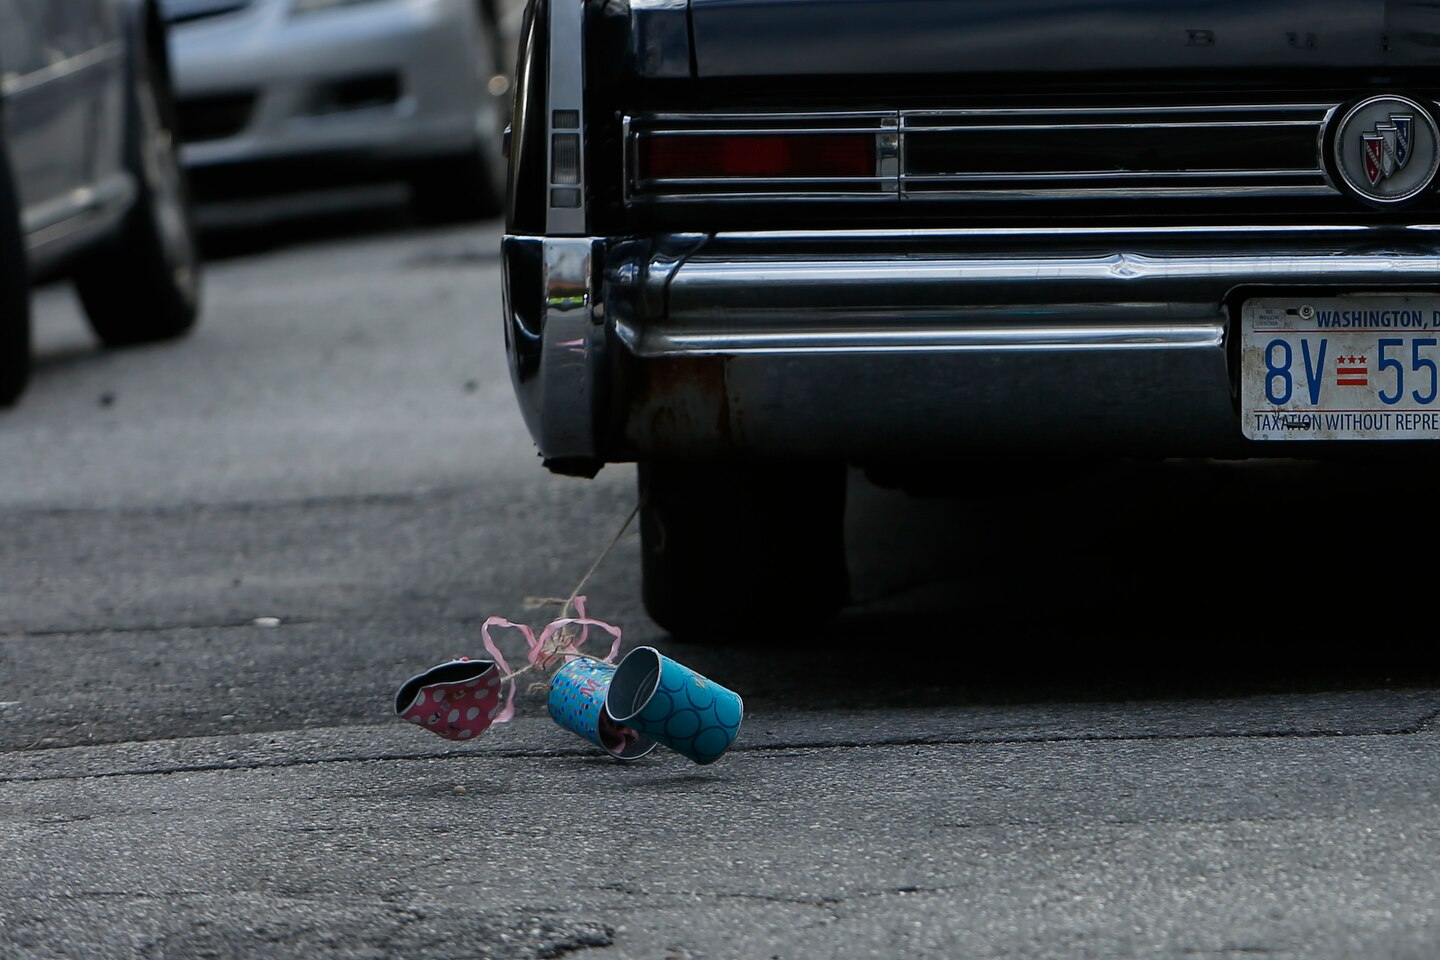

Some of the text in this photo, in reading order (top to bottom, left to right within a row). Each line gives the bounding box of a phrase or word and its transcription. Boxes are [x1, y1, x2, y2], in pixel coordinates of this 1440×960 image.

[1316, 310, 1427, 330] WASHINGTON,
[1264, 338, 1328, 406] 8V
[1254, 413, 1322, 431] TAXATION
[1325, 413, 1392, 431] WITHOUT
